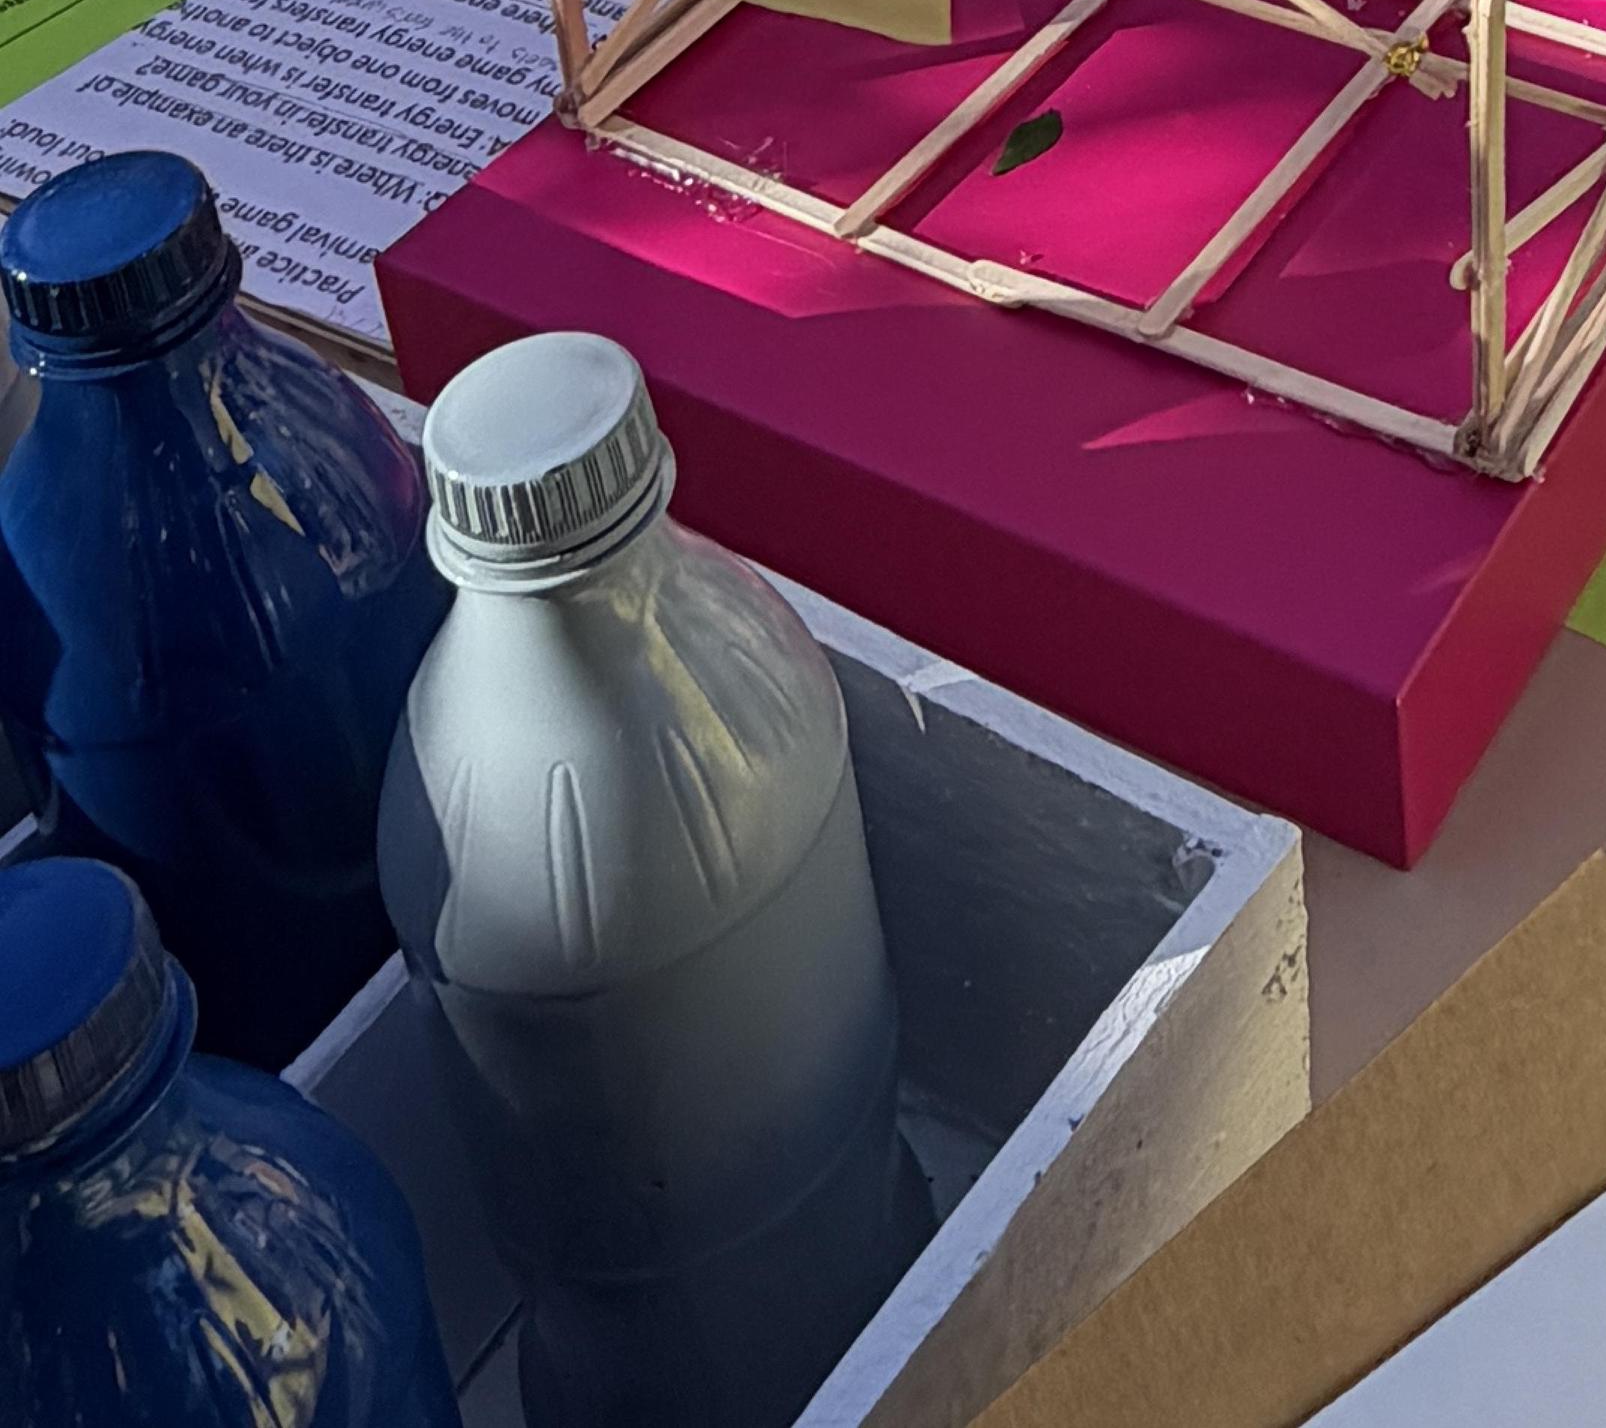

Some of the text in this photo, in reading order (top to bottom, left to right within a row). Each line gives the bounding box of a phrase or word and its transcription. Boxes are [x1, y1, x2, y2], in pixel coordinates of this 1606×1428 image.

[247, 23, 277, 42] to
[500, 3, 561, 35] here
[272, 29, 354, 65] object
[367, 24, 457, 62] energy
[75, 73, 119, 93] of
[135, 54, 227, 93] game?
[350, 54, 401, 80] one
[454, 53, 535, 86] game
[111, 80, 215, 127] example
[130, 18, 513, 157] A: Energy transfer is when energy
[214, 77, 282, 112] your
[399, 69, 460, 104] from
[524, 74, 571, 99] my
[273, 99, 304, 126] in
[456, 89, 541, 126] moves
[210, 115, 249, 139] an
[295, 107, 395, 155] transfer
[244, 128, 316, 164] there
[309, 149, 339, 175] is
[333, 155, 425, 205] Where
[219, 197, 300, 234] game
[284, 222, 380, 265] arnival
[256, 250, 367, 305] Practice
